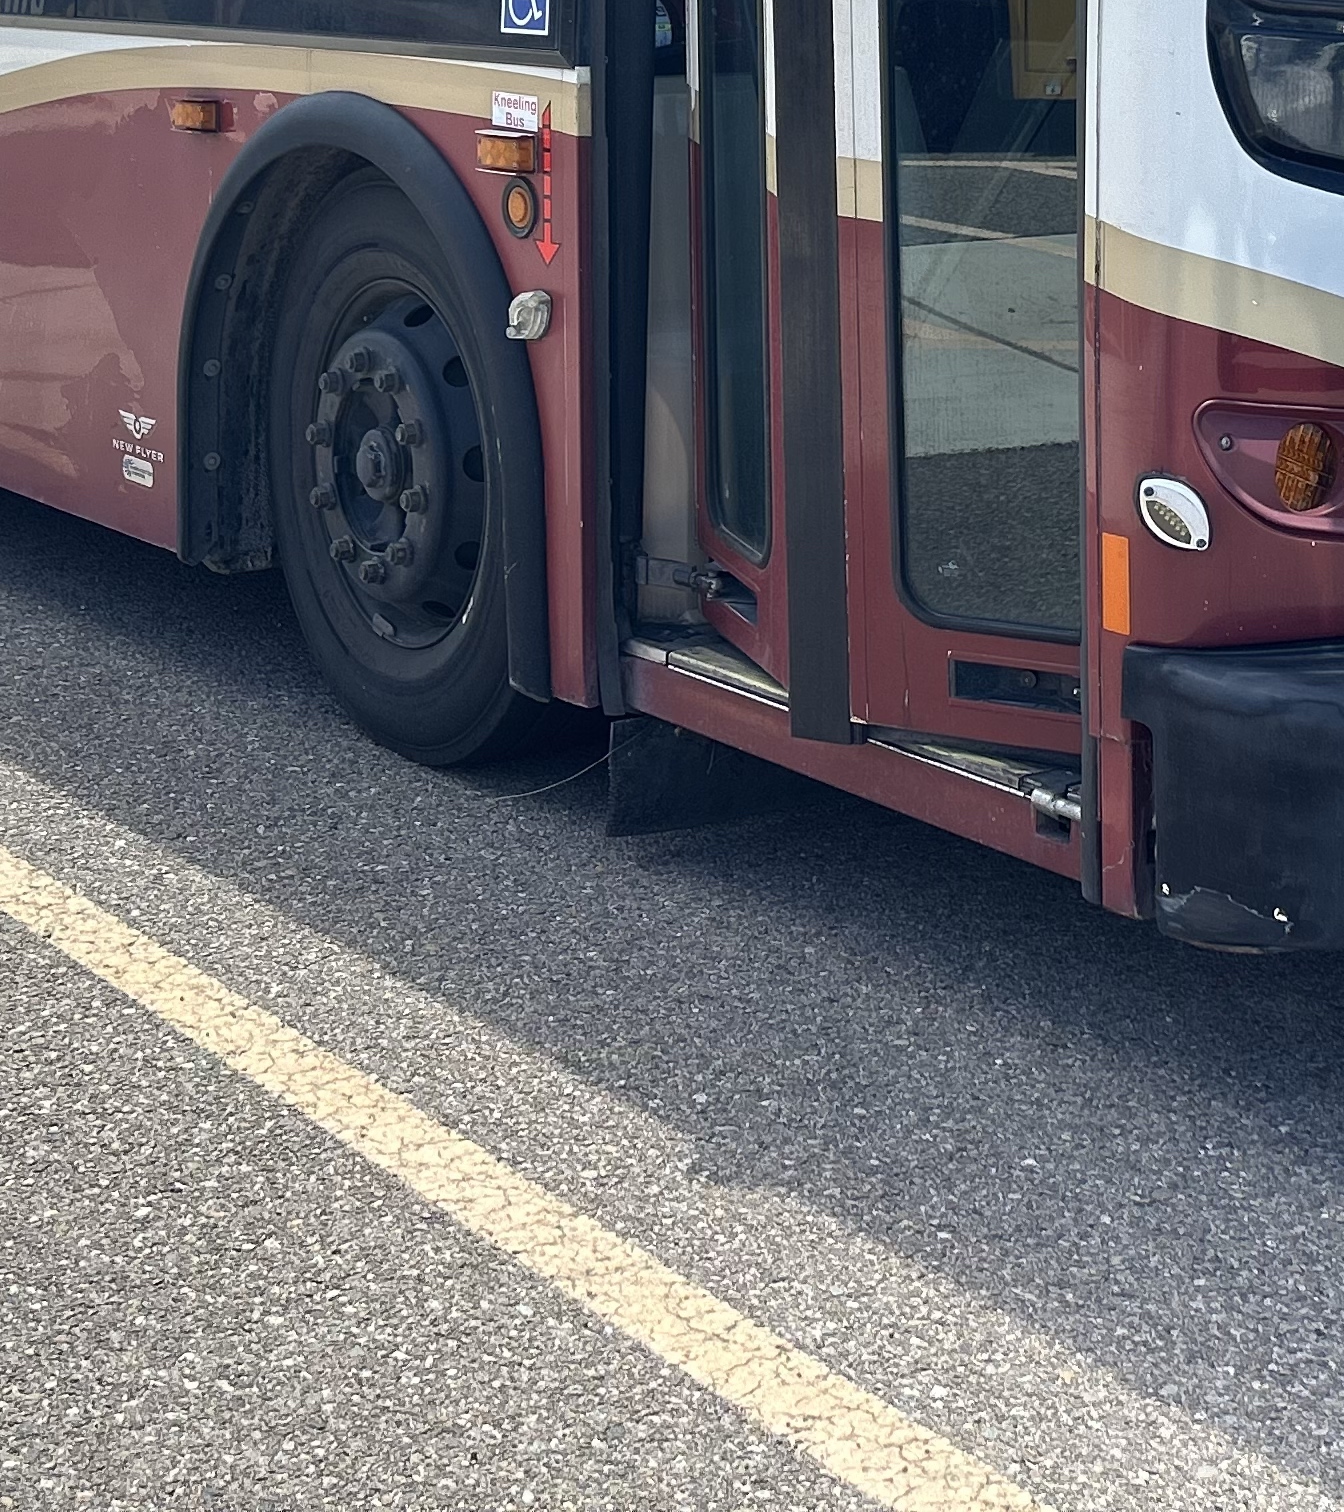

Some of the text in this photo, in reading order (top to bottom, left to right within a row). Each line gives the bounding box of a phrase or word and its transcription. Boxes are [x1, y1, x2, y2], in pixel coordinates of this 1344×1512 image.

[493, 92, 537, 115] Kneeling
[505, 112, 525, 128] Bus
[112, 438, 165, 463] NEW FLYER
